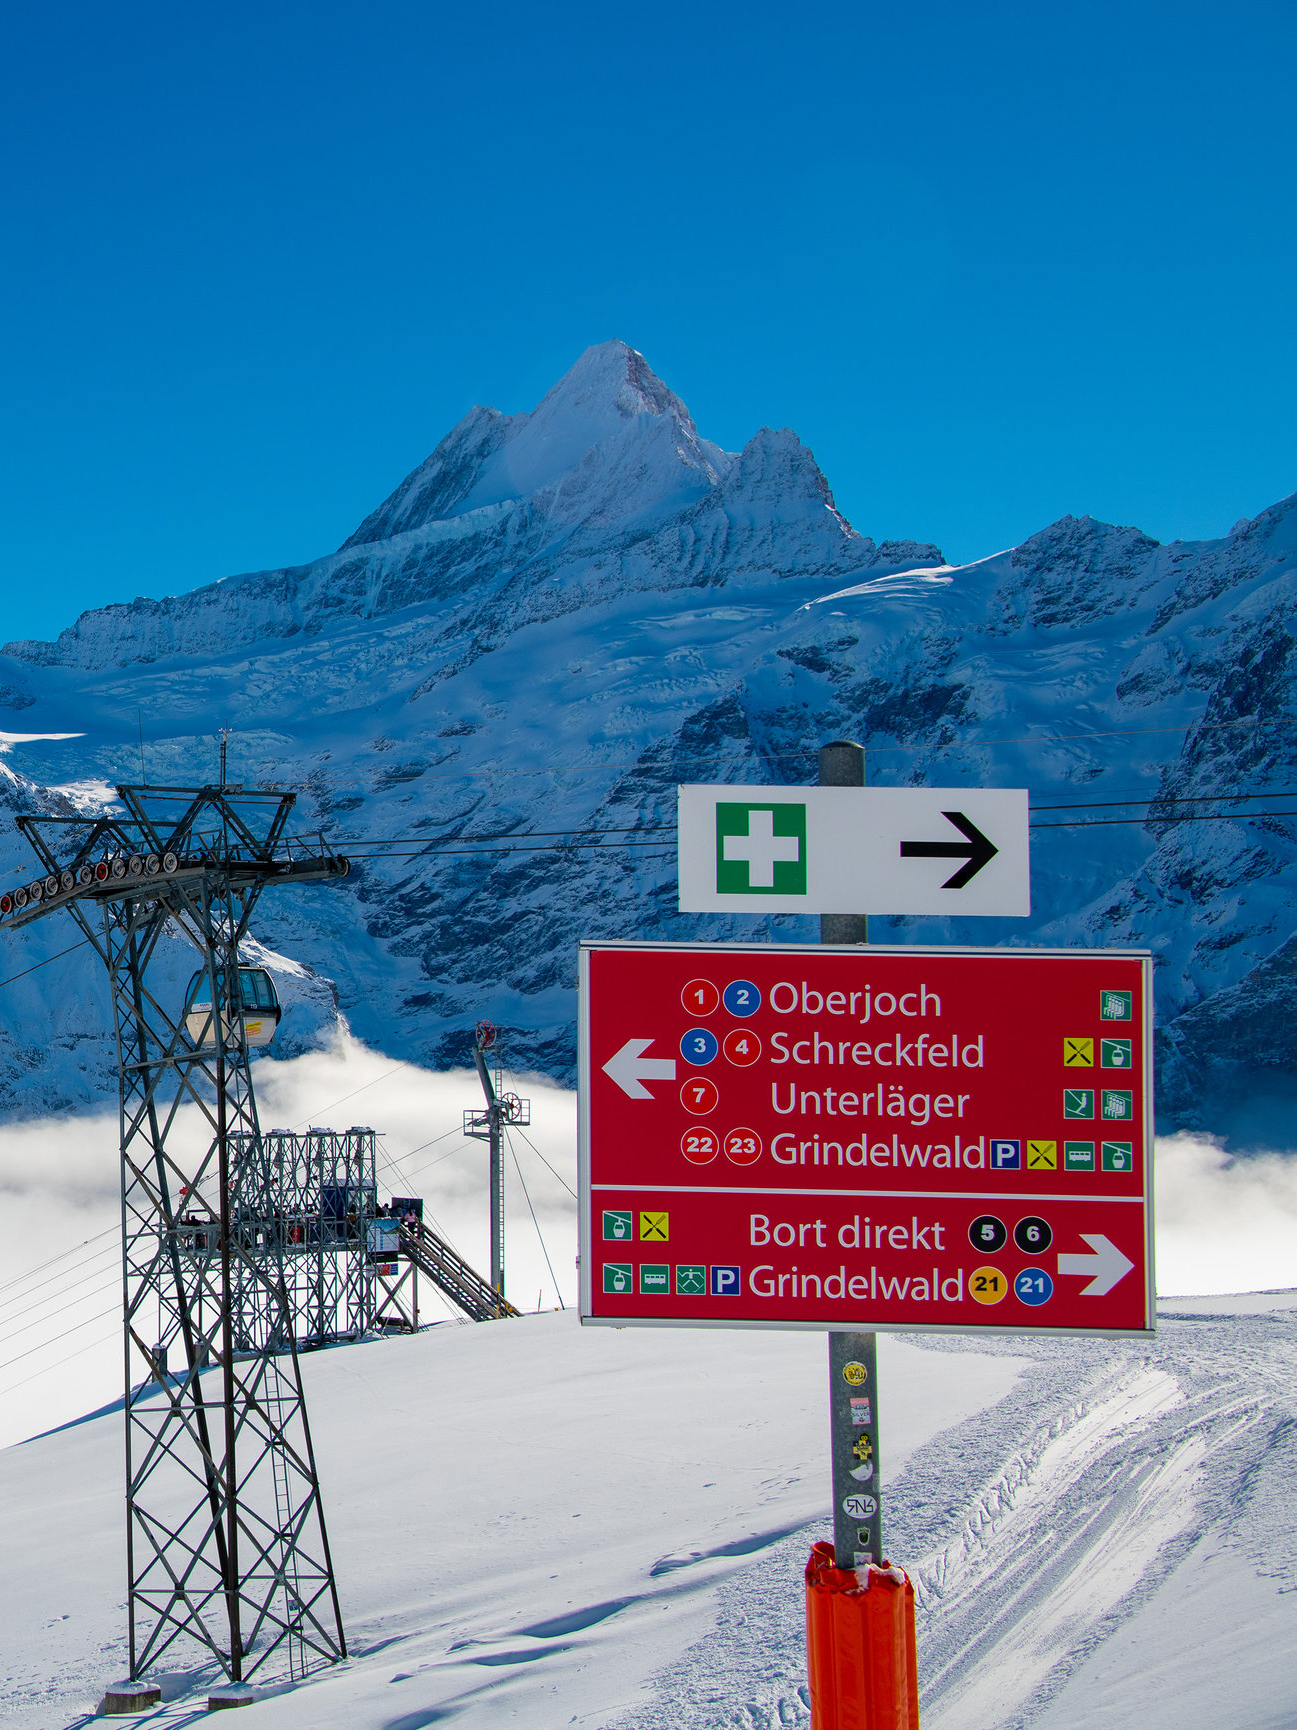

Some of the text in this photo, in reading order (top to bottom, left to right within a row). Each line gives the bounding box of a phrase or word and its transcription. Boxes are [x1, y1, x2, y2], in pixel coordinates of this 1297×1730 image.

[694, 982, 941, 1024] 1 2 Oberjoch
[694, 1032, 984, 1068] 3 4 Schreckfeld
[693, 1083, 970, 1126] 7 Unterläger
[686, 1133, 1015, 1168] 22 23 Grindelwald P
[751, 1214, 1040, 1250] Bort direkt 5 6
[717, 1265, 1044, 1301] P Grindelwald 21 21
